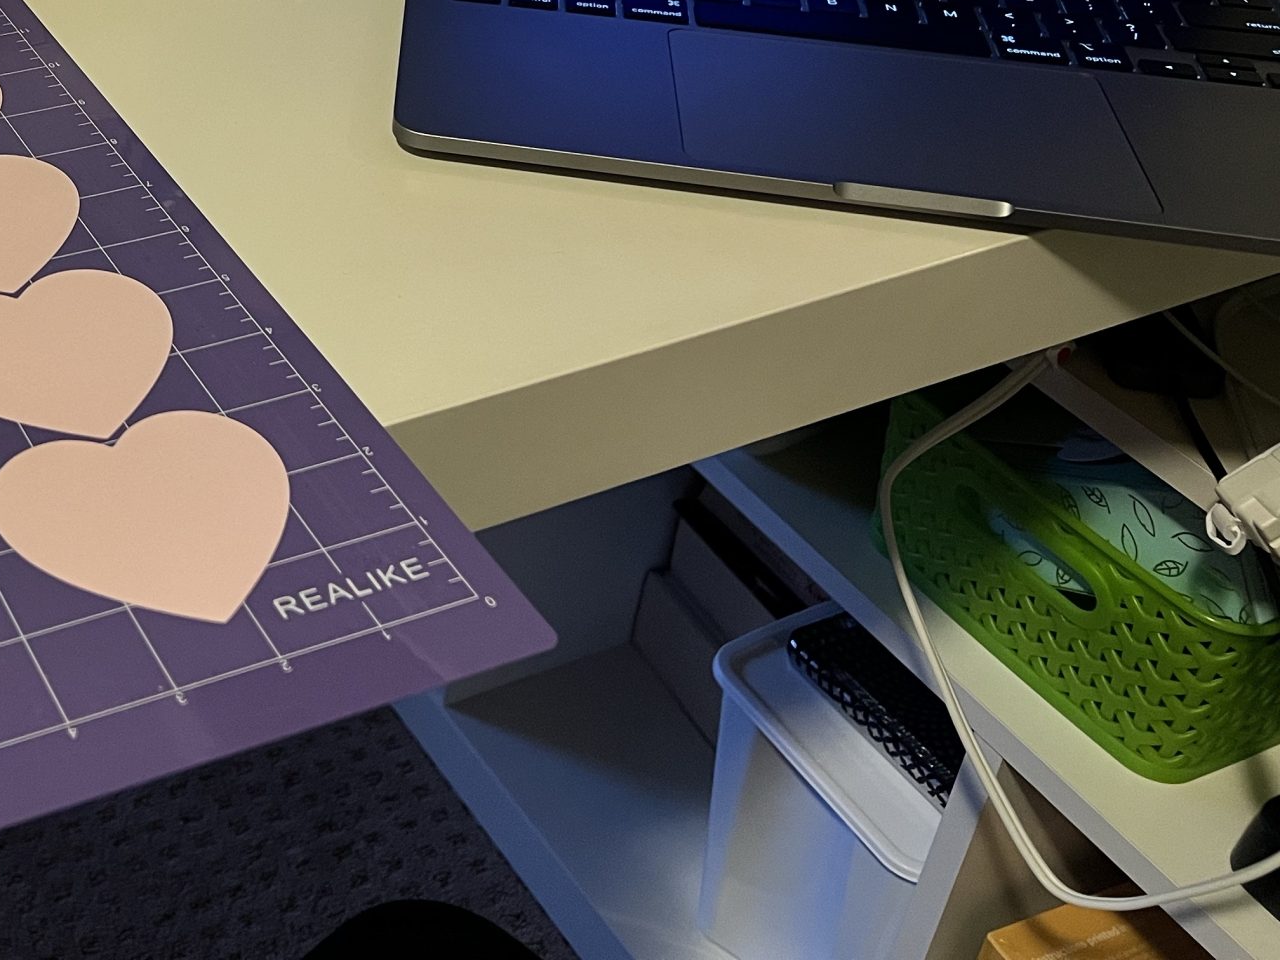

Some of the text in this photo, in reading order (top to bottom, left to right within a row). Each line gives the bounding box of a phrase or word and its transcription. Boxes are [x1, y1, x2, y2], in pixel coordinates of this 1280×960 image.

[576, 1, 609, 9] option
[631, 7, 682, 17] command
[1006, 48, 1061, 58] command
[1085, 56, 1122, 64] option
[272, 556, 431, 620] REALIKE
